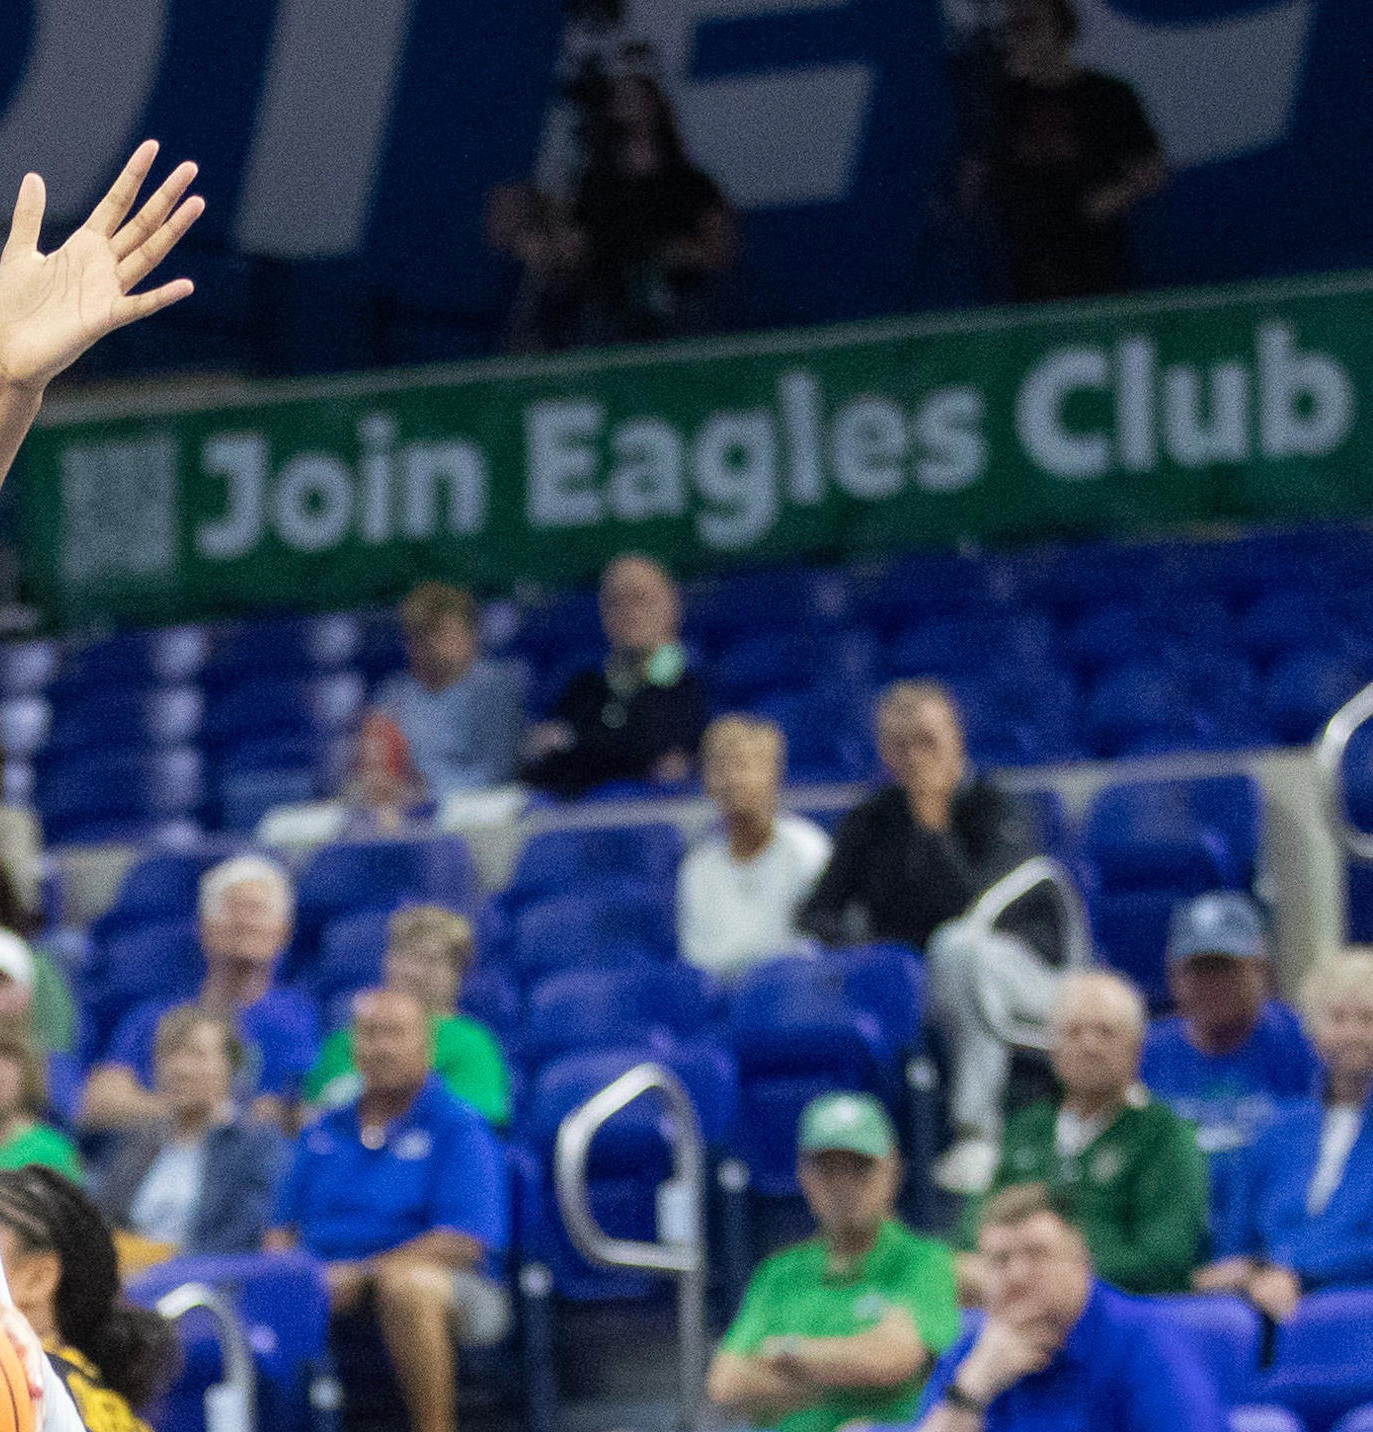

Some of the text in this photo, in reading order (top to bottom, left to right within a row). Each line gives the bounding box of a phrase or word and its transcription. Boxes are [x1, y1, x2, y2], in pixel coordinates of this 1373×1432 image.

[193, 322, 1355, 561] Join Eagles Club
